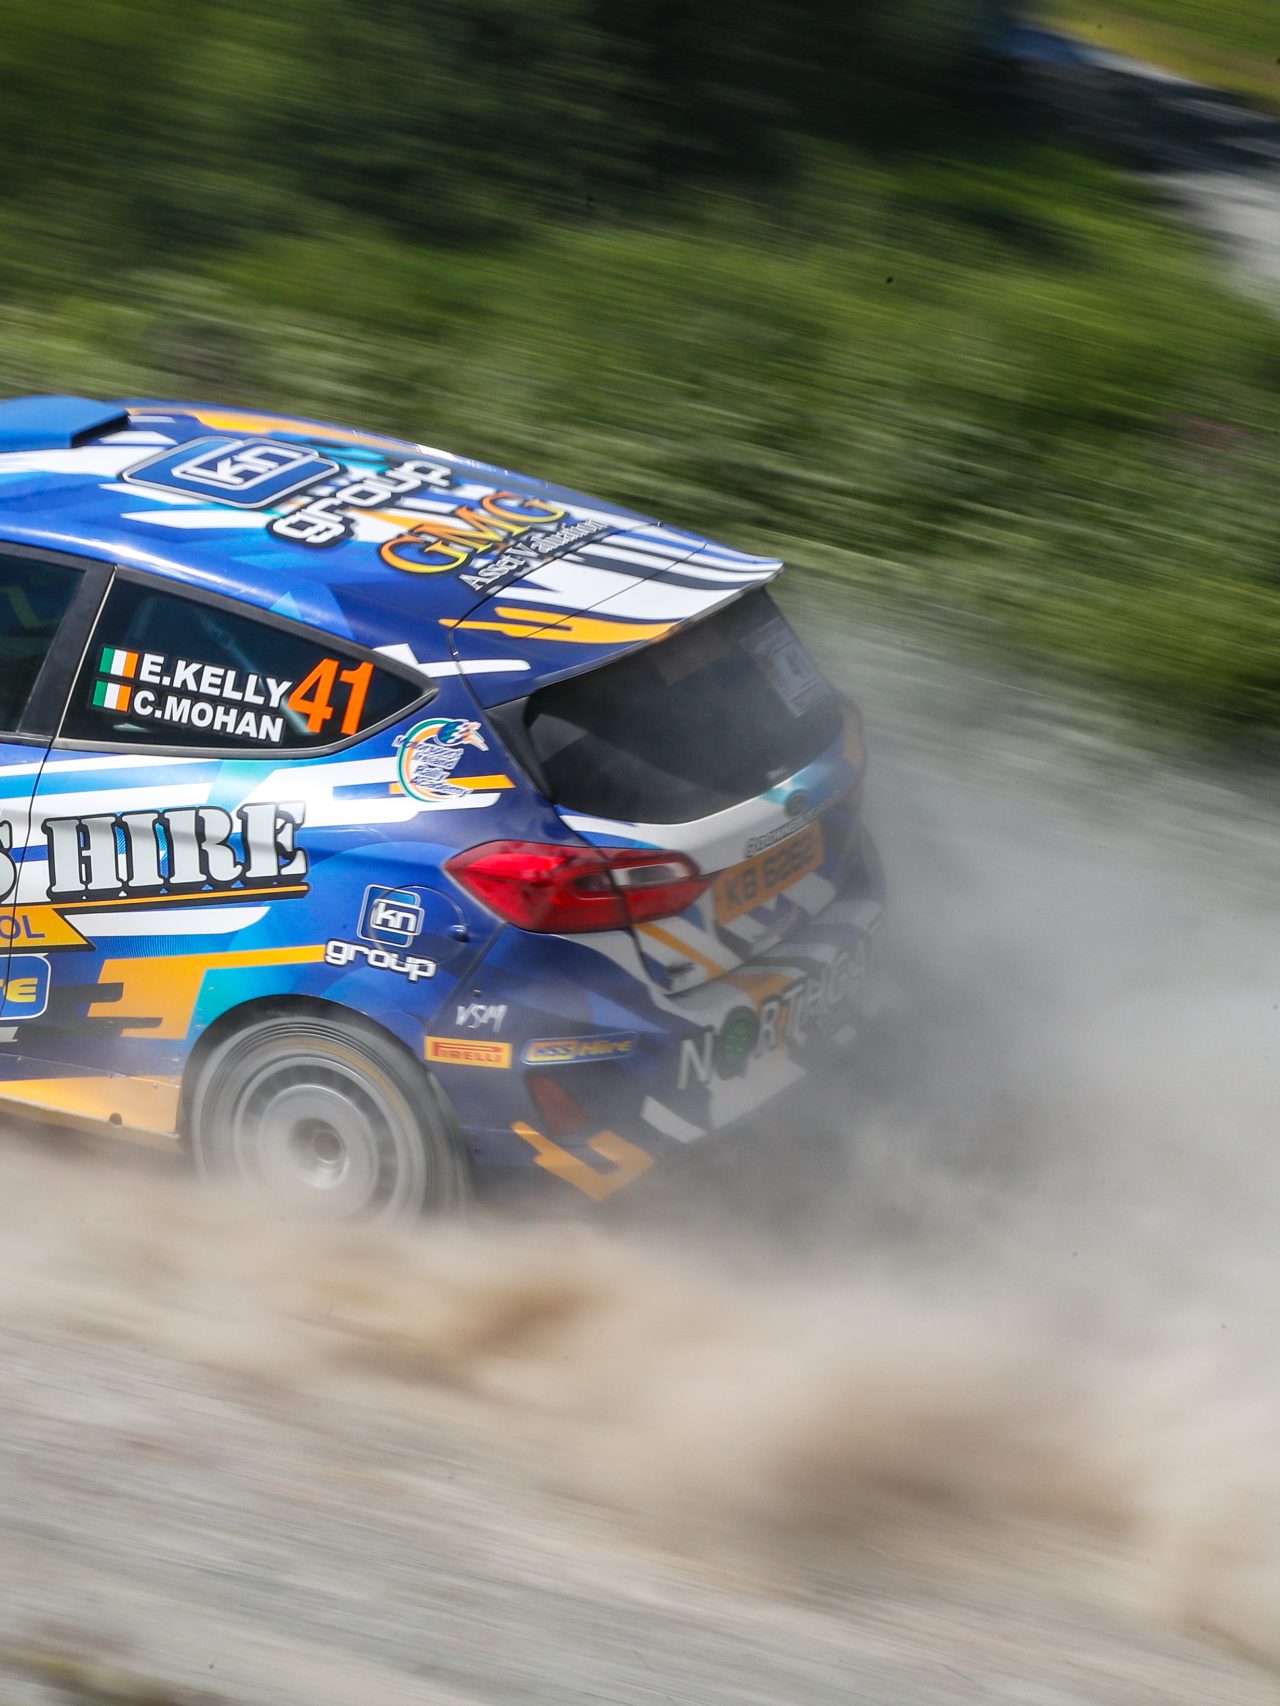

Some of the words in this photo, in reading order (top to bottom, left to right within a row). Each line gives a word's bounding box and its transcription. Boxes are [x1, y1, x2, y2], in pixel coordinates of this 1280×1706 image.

[272, 459, 452, 544] group
[381, 490, 566, 573] GMG
[459, 553, 526, 591] Asset
[139, 653, 293, 707] E.KELLY
[287, 657, 375, 735] 41
[133, 694, 284, 743] C.MOHAN
[41, 801, 308, 900] HIRE
[325, 940, 437, 981] group
[432, 1041, 503, 1063] PIRELLI
